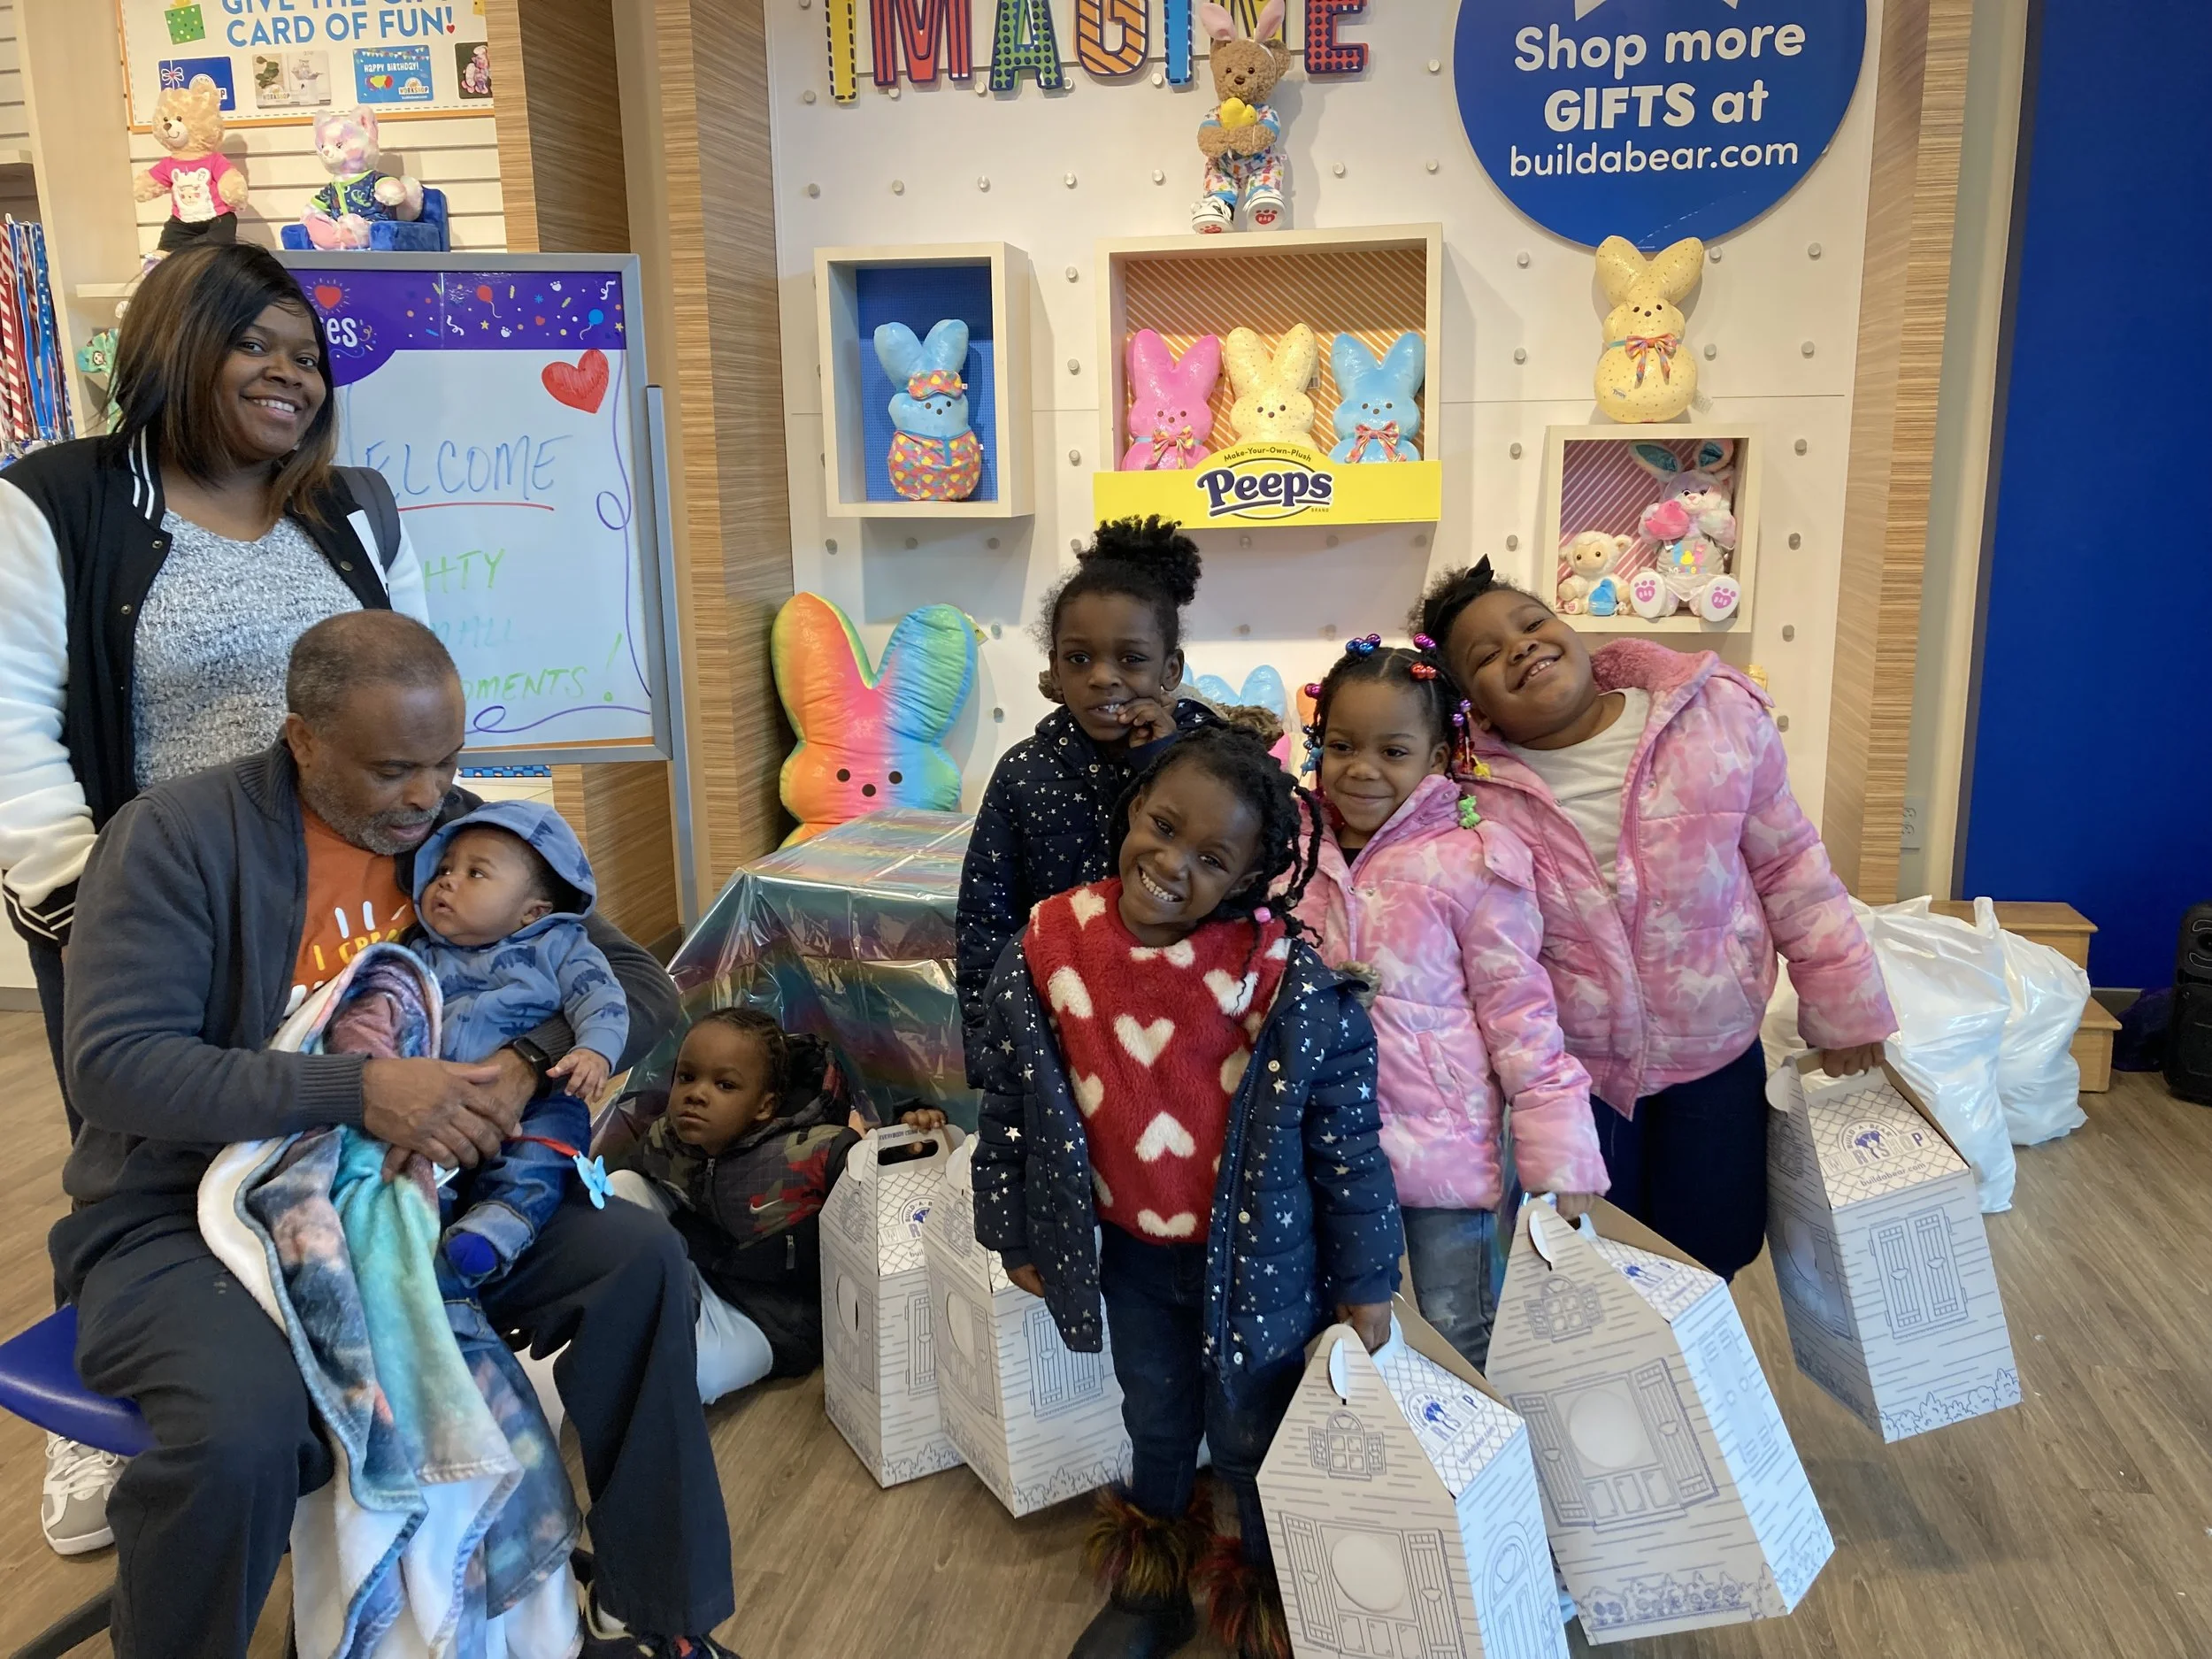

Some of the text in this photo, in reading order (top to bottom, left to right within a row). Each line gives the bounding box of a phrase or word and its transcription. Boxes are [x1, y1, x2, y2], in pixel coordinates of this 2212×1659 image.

[227, 6, 455, 47] CARD OF FUN!
[826, 0, 1369, 103] IMAGIE
[1515, 24, 1806, 81] Shop more
[1544, 79, 1769, 132] GIFTS at
[1510, 140, 1798, 177] buildabear.com
[321, 317, 358, 348] es
[365, 434, 573, 501] ELCOME
[1224, 446, 1312, 462] Make-Your-Own-Plush
[1197, 469, 1333, 508] Peeps
[424, 548, 506, 594] HTY
[432, 615, 514, 648] MALL
[1860, 1162, 1926, 1187] buildabear.com
[1422, 1394, 1479, 1456] RKSOP
